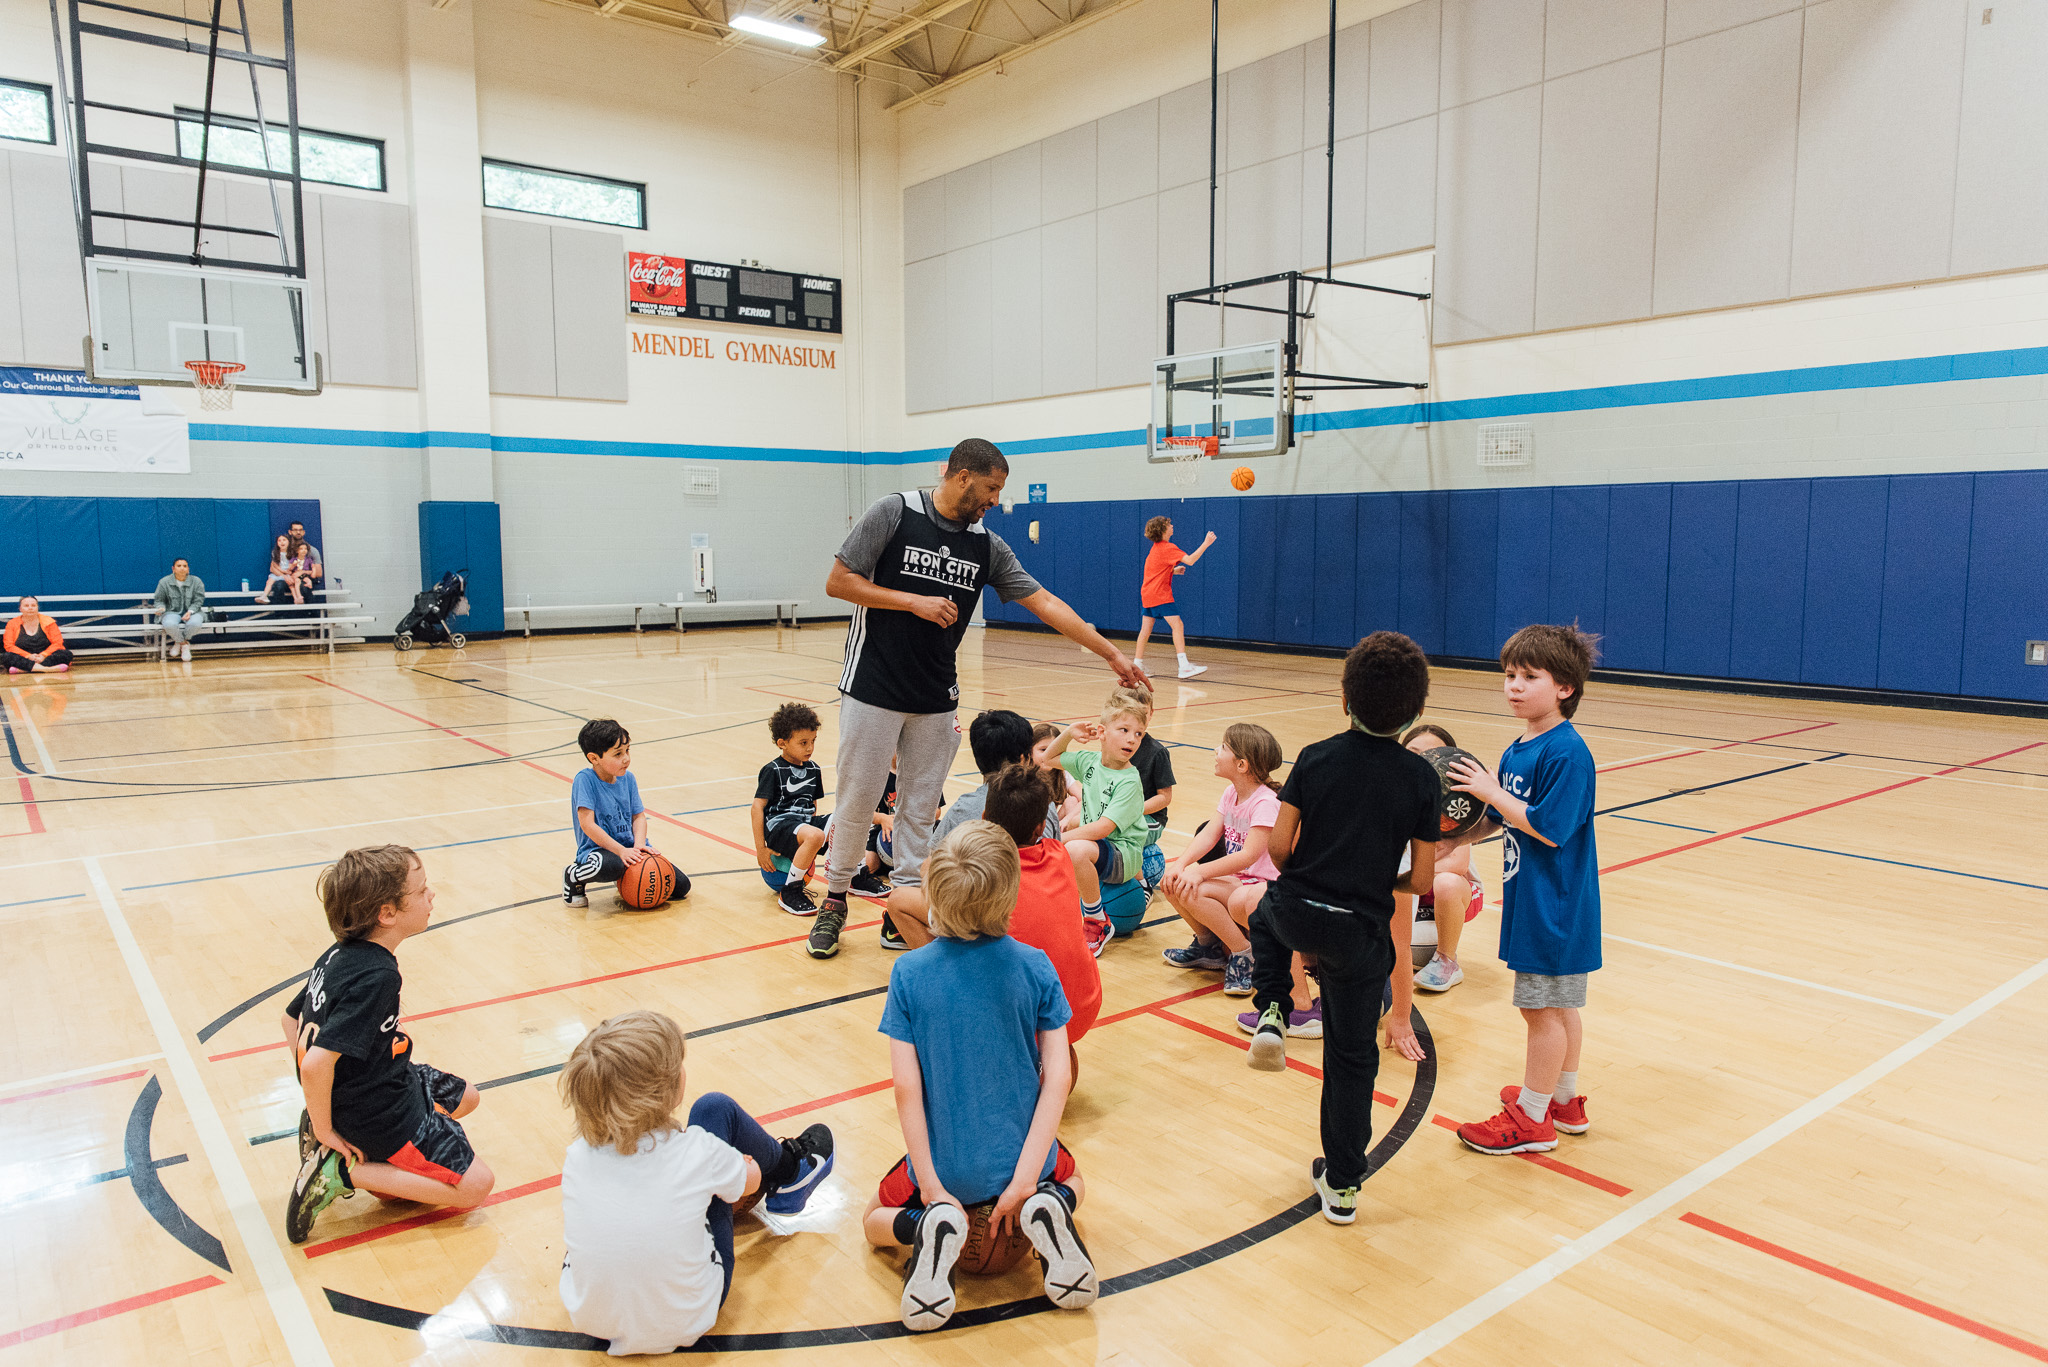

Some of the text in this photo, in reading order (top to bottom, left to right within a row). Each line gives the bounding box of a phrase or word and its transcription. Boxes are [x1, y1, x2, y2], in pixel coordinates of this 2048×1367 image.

[692, 264, 730, 279] GUEST
[803, 278, 834, 291] HOME
[631, 301, 658, 310] ALWAYS
[659, 304, 676, 312] PART
[657, 309, 678, 317] TEAM!
[739, 306, 771, 318] PERIOD
[632, 332, 836, 369] MENDEL GYMNASIUM
[33, 373, 74, 383] THANK
[2, 381, 20, 389] Our
[21, 382, 63, 391] Generous
[64, 384, 108, 394] Basketball
[25, 426, 118, 442] VILLAGE
[27, 443, 118, 451] ORTHODONTICS
[903, 549, 941, 571] IRON
[946, 560, 979, 580] CITY
[904, 563, 974, 588] BASKETBALL
[643, 870, 656, 905] Wilson
